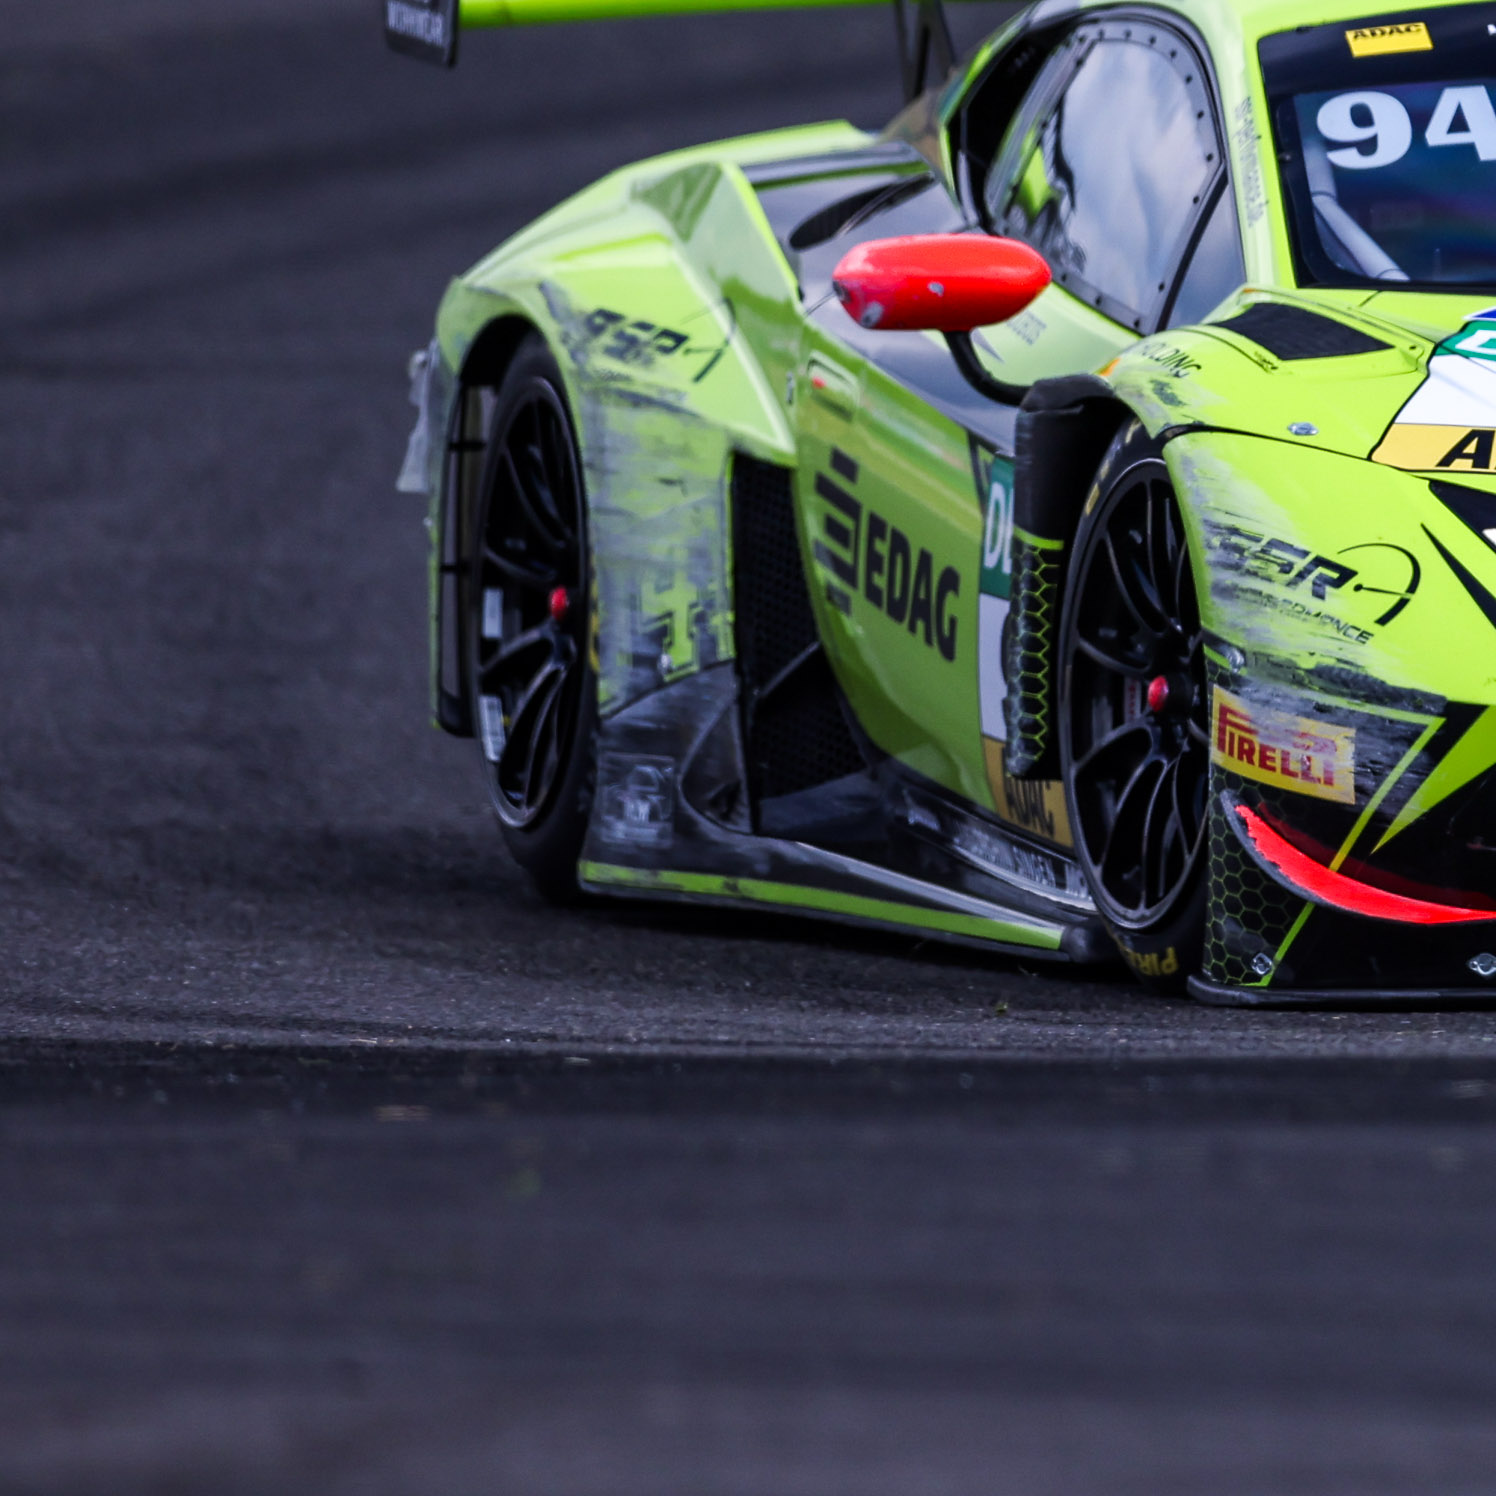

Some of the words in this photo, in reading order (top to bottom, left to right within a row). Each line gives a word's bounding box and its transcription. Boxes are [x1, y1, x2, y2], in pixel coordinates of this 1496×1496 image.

[1353, 23, 1423, 41] ADAC
[865, 510, 961, 663] EDAG
[1216, 702, 1338, 788] PIRELLI
